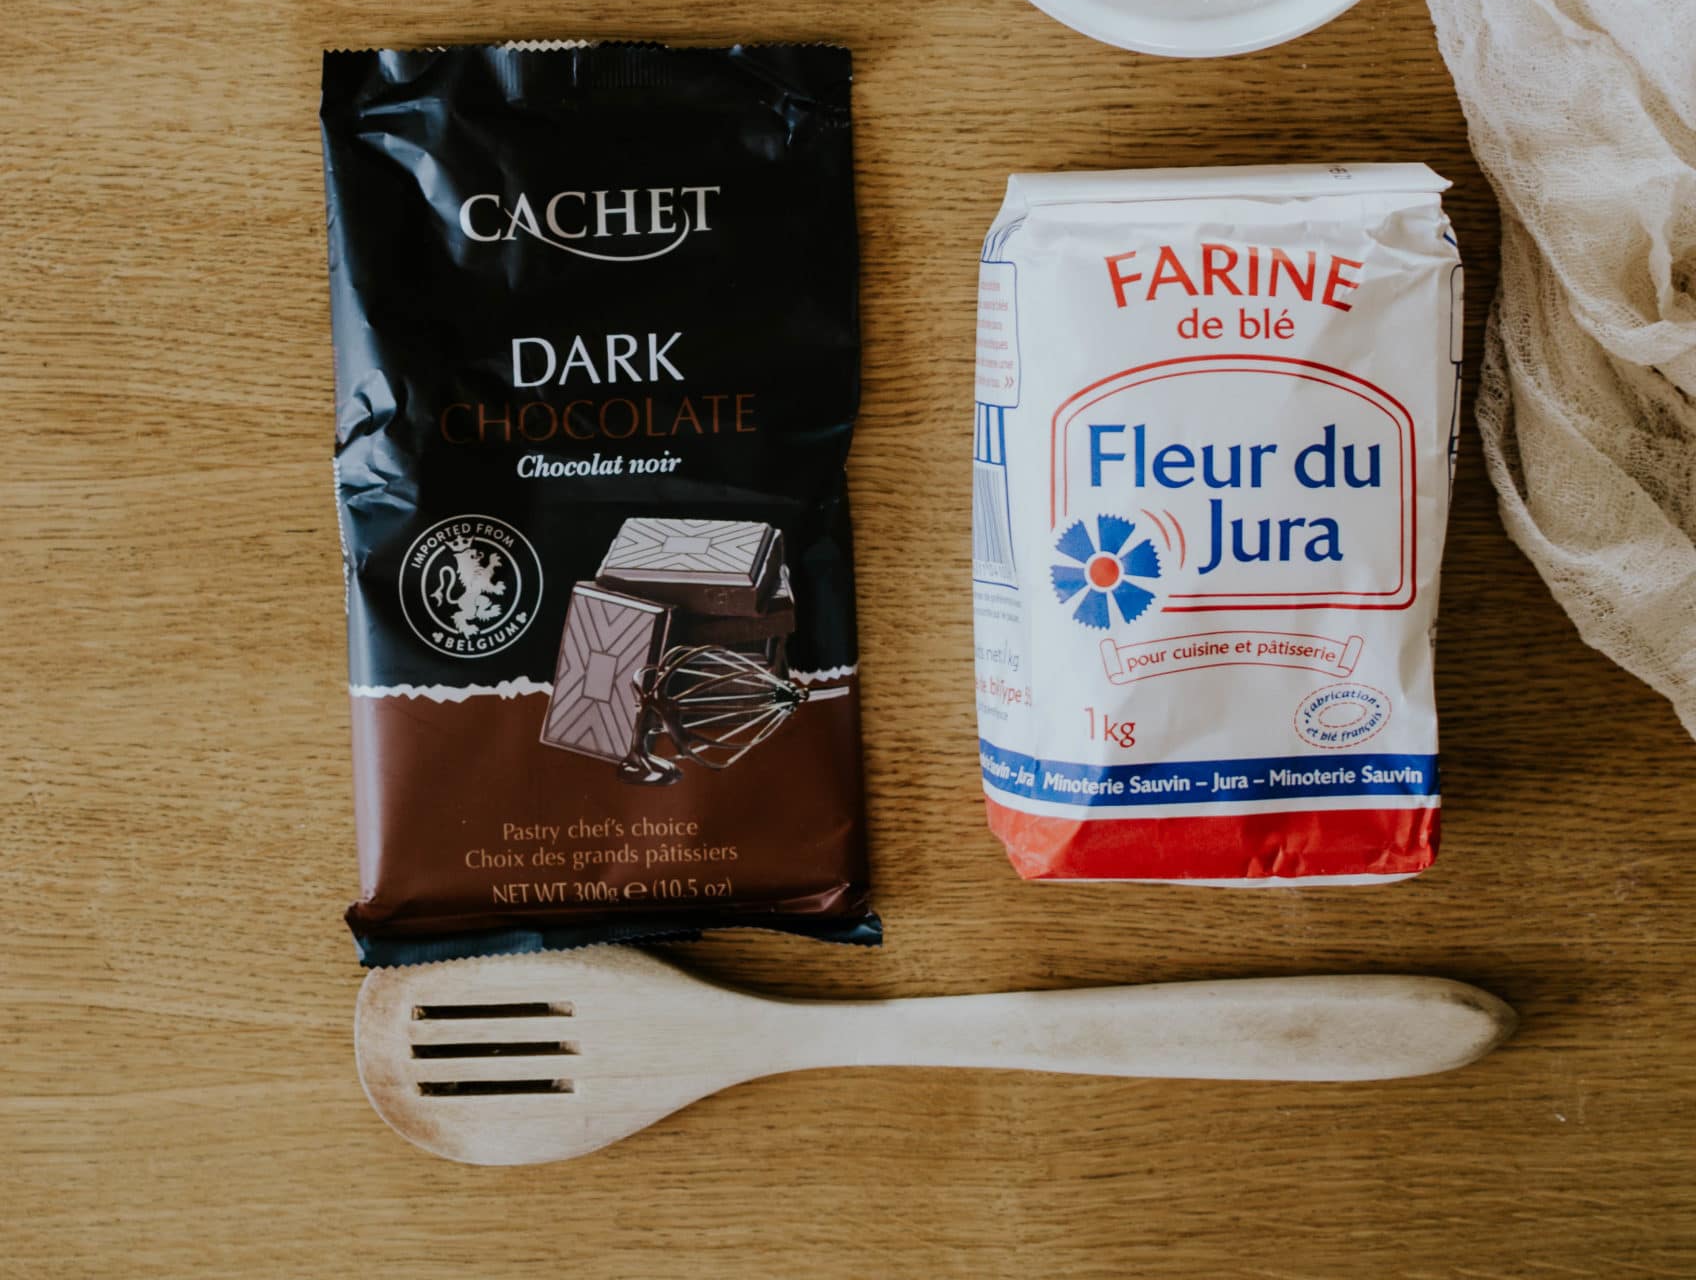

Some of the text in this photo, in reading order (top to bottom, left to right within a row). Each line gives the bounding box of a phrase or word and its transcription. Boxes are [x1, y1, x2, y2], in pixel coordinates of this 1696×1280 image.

[458, 185, 721, 261] CACHET
[1104, 243, 1364, 312] FARINE
[1177, 308, 1294, 339] de blé
[511, 331, 685, 388] DARK
[440, 393, 757, 446] CHOCOLATE
[516, 450, 682, 478] Chocolat noir
[1087, 423, 1381, 489] Fleur du
[411, 523, 515, 569] IMPORTED FROM
[1198, 498, 1344, 576] Jura
[444, 622, 520, 652] BELGIUM
[1126, 639, 1336, 672] pour cuisine et pâtisserie
[1304, 688, 1377, 718] Fabrication
[1320, 731, 1337, 742] blé
[1341, 712, 1382, 742] français
[1043, 772, 1123, 795] Minoterie
[1129, 774, 1190, 794] Sauvin
[1211, 772, 1248, 792] Jura
[1270, 767, 1356, 787] Minoterie
[1361, 765, 1423, 785] Sauvin
[503, 822, 560, 845] Pastry
[631, 817, 699, 837] choice
[465, 842, 738, 869] Choix des grands pâtissiers
[492, 884, 529, 904] NET
[534, 882, 567, 903] WT
[573, 881, 618, 902] 300g
